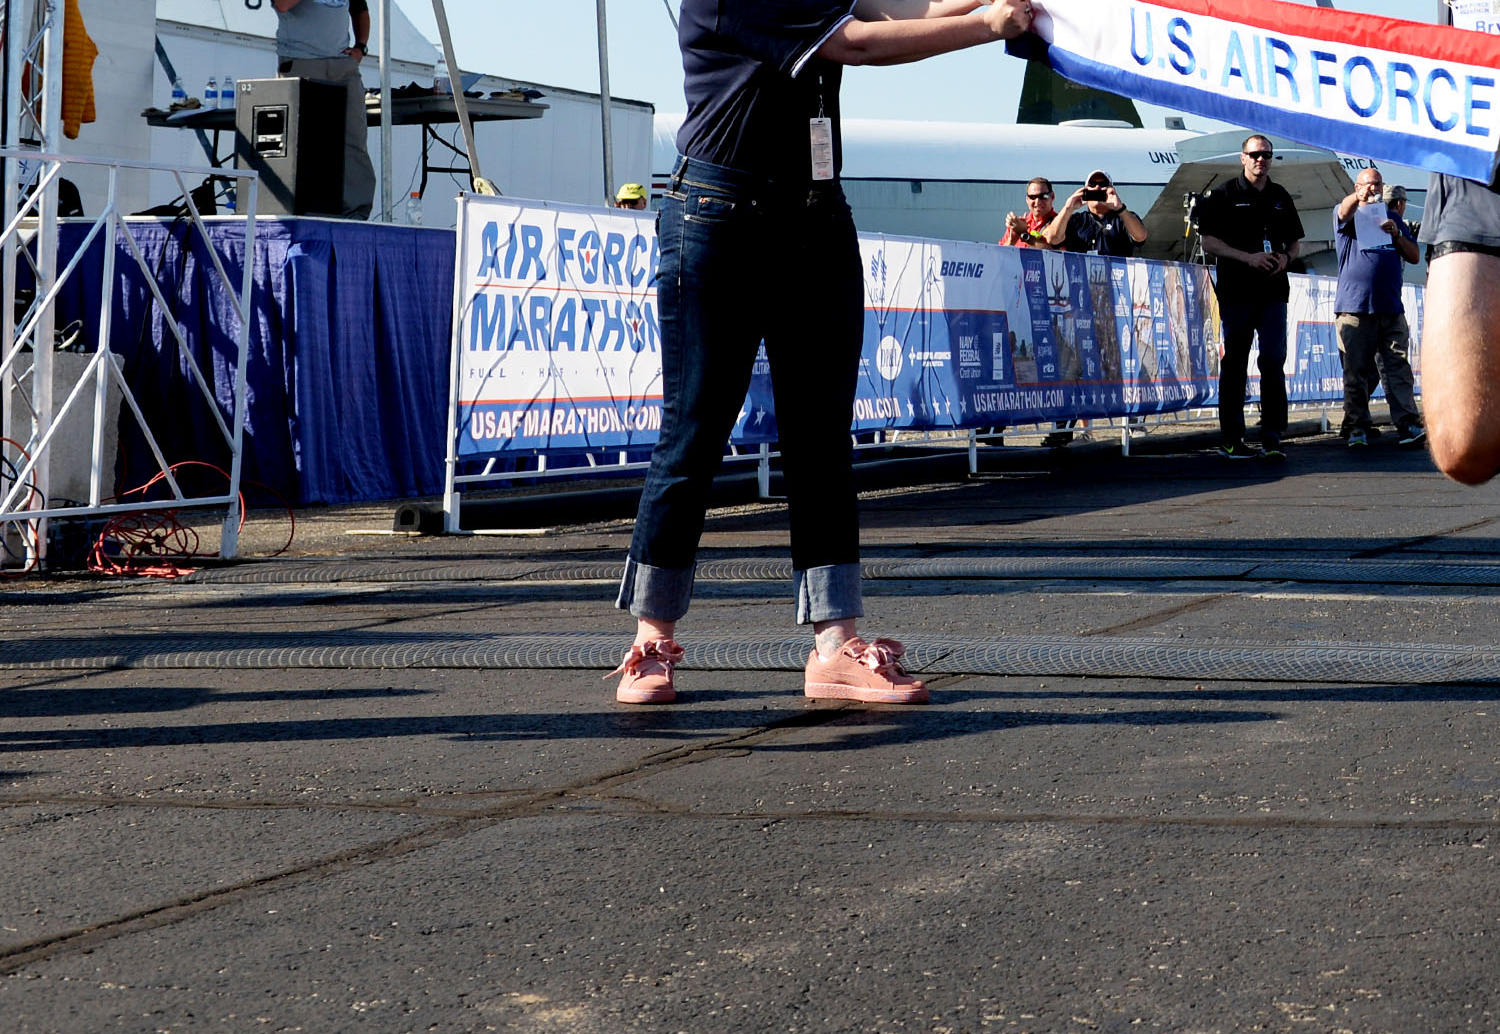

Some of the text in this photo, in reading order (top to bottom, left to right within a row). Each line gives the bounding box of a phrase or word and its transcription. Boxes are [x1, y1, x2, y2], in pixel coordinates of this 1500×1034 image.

[1130, 7, 1496, 138] U.S. AIR FORCE
[477, 221, 547, 281] AIR
[940, 261, 984, 278] BOEING
[973, 390, 1064, 412] USAFMARATHON.COM
[1122, 384, 1197, 404] USAFMARATHON.COM
[471, 406, 663, 441] USAFMARATHON.COM
